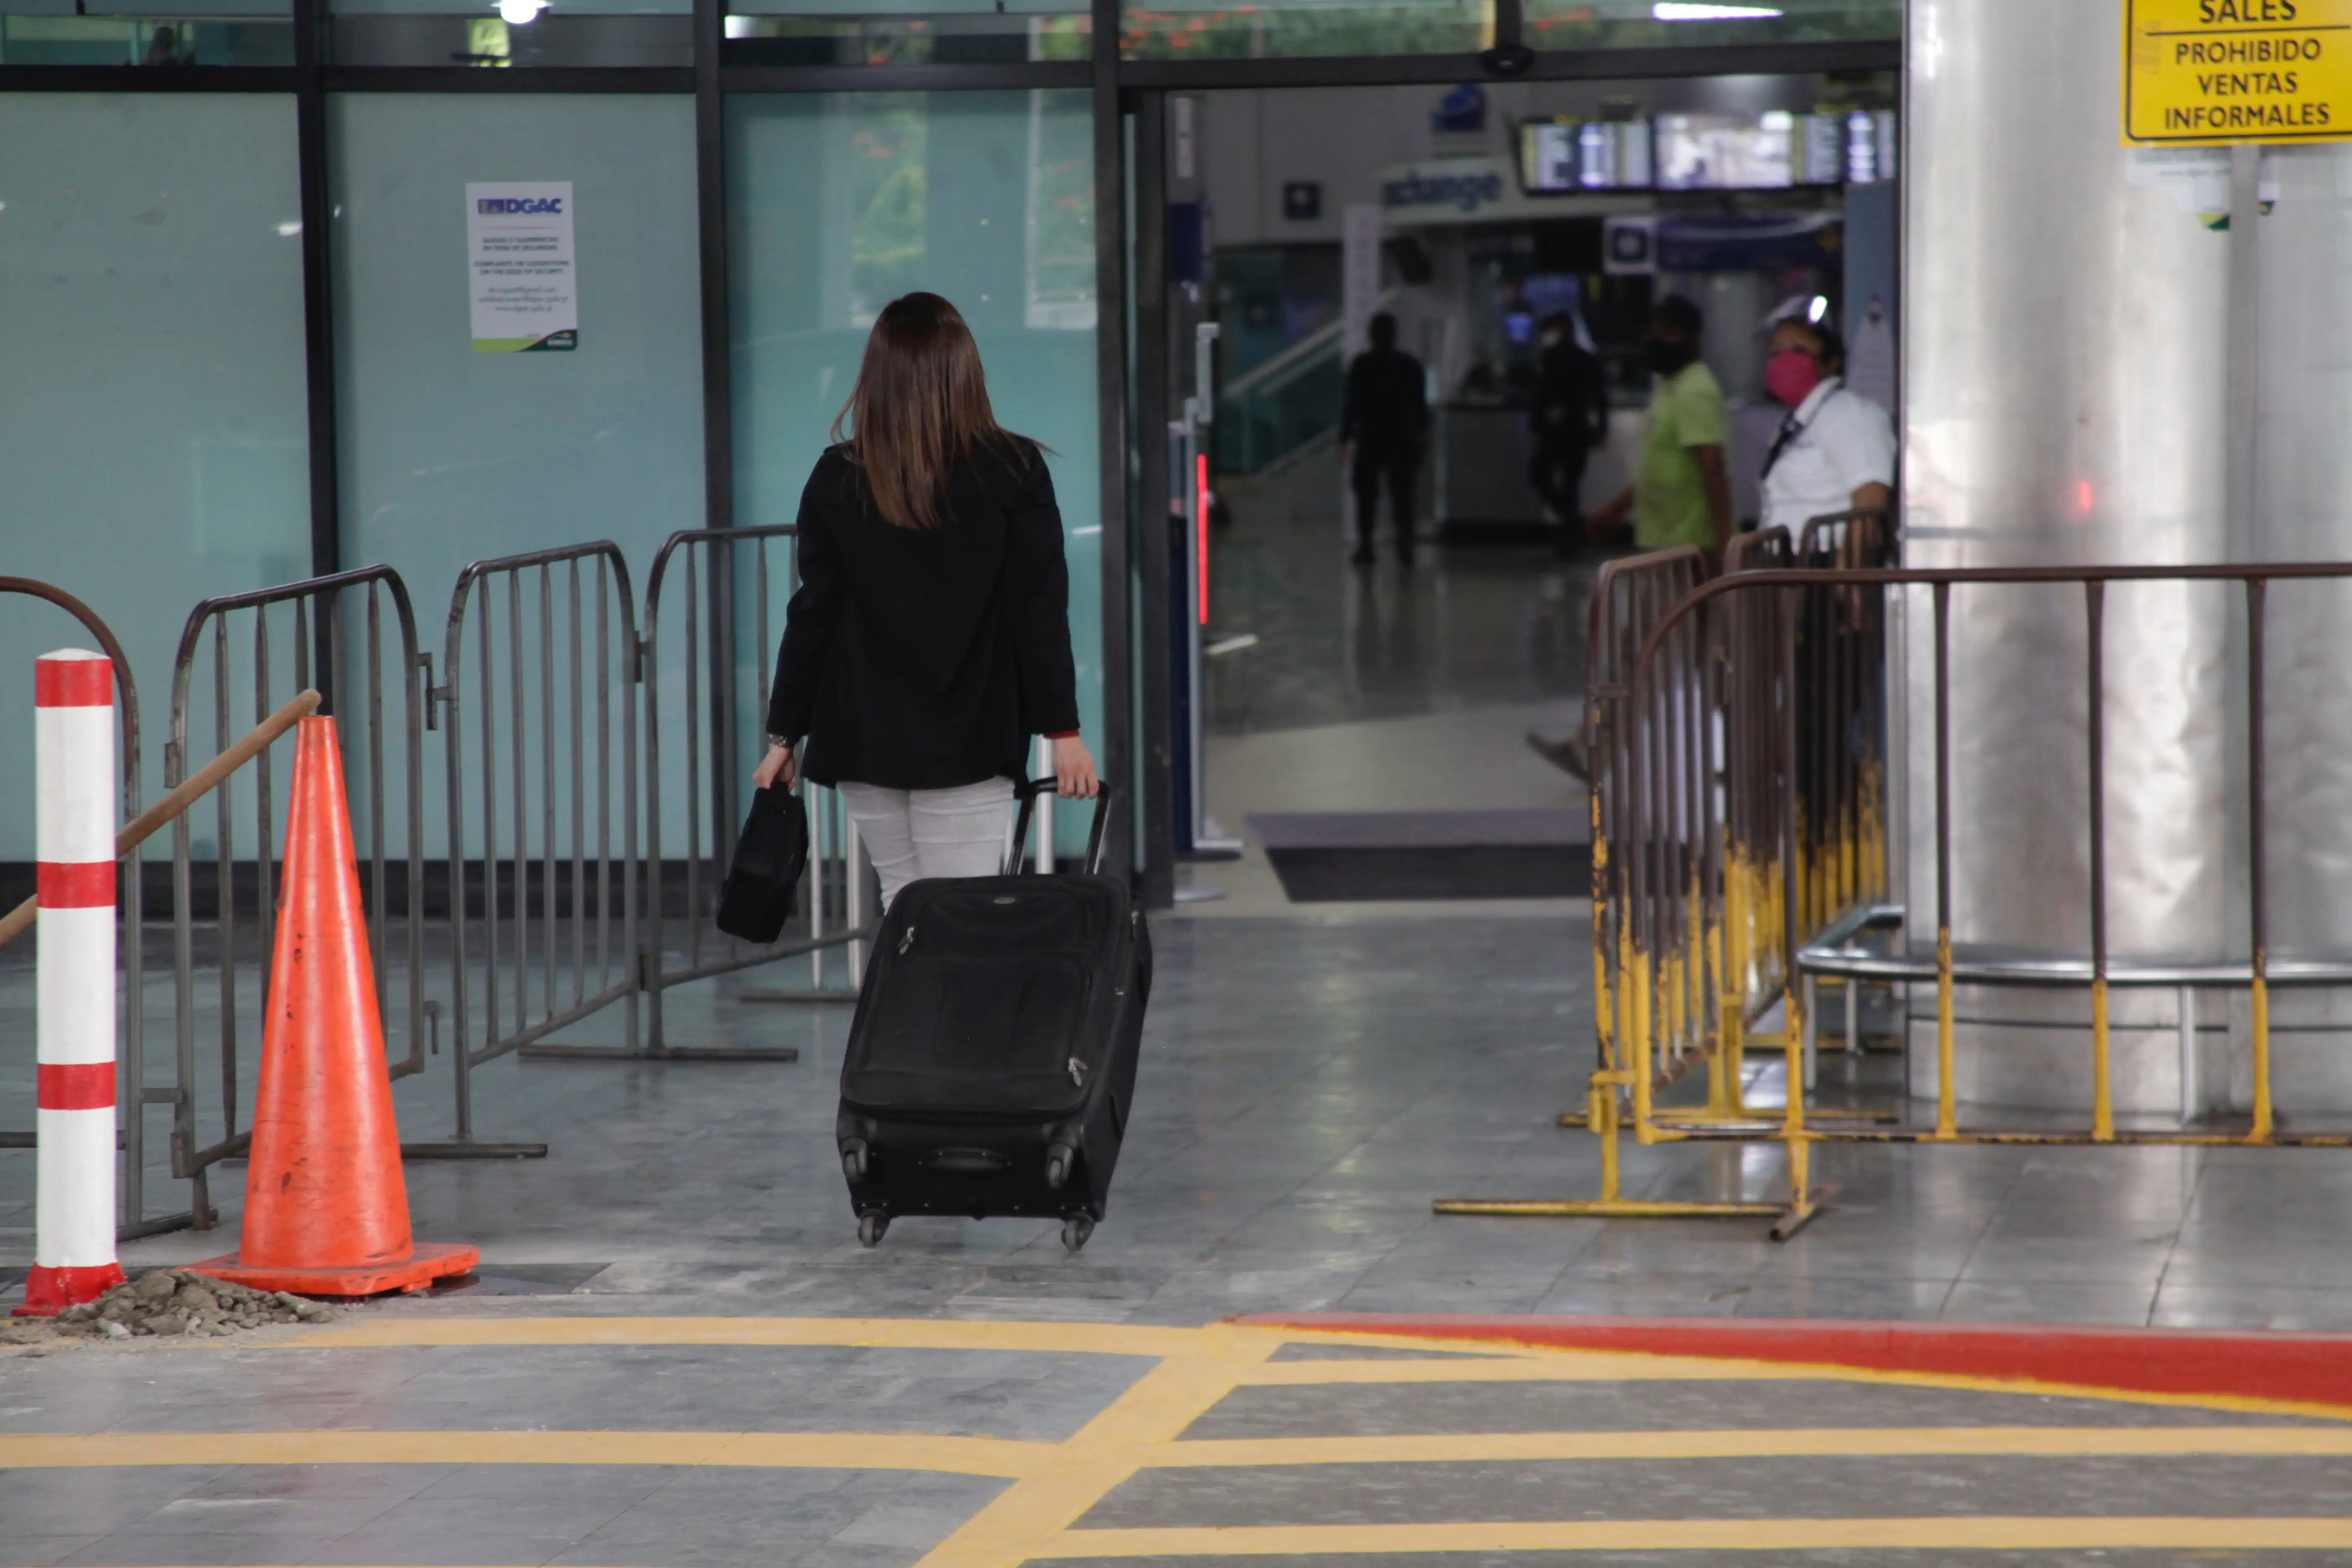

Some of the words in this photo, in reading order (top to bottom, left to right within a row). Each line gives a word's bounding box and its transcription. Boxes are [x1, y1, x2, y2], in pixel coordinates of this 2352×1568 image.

[2200, 0, 2296, 23] SALES
[2176, 38, 2321, 64] PROHIBIDO
[2197, 72, 2298, 96] VENTAS
[2165, 103, 2330, 129] INFORMALES
[506, 198, 562, 214] DGAC
